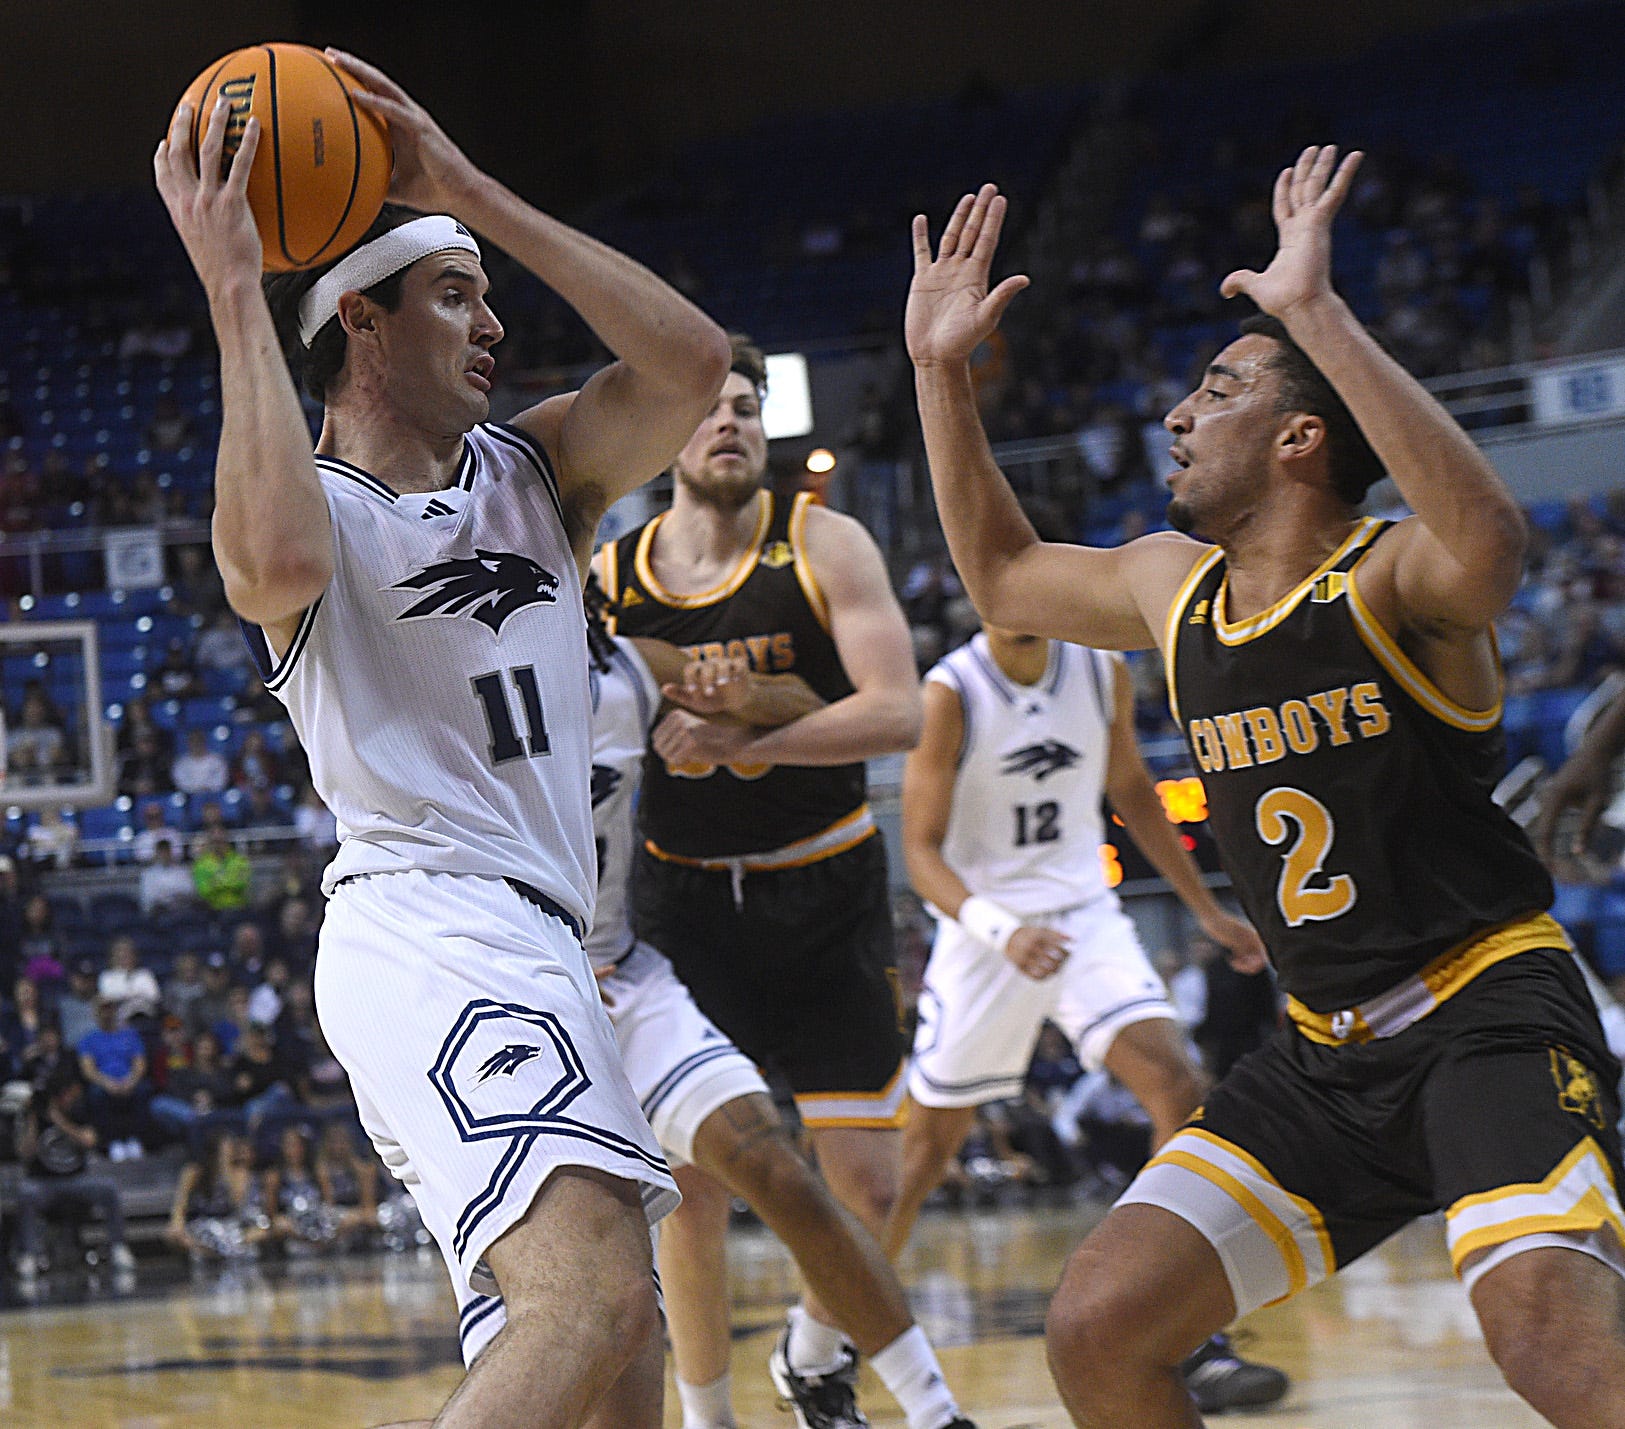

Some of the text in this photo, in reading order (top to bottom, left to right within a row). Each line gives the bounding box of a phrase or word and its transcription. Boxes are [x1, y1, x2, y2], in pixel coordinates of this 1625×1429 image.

[469, 664, 552, 767] 11
[1190, 683, 1391, 773] COWBOYS
[1014, 801, 1061, 847] 12
[1255, 787, 1357, 927] 2
